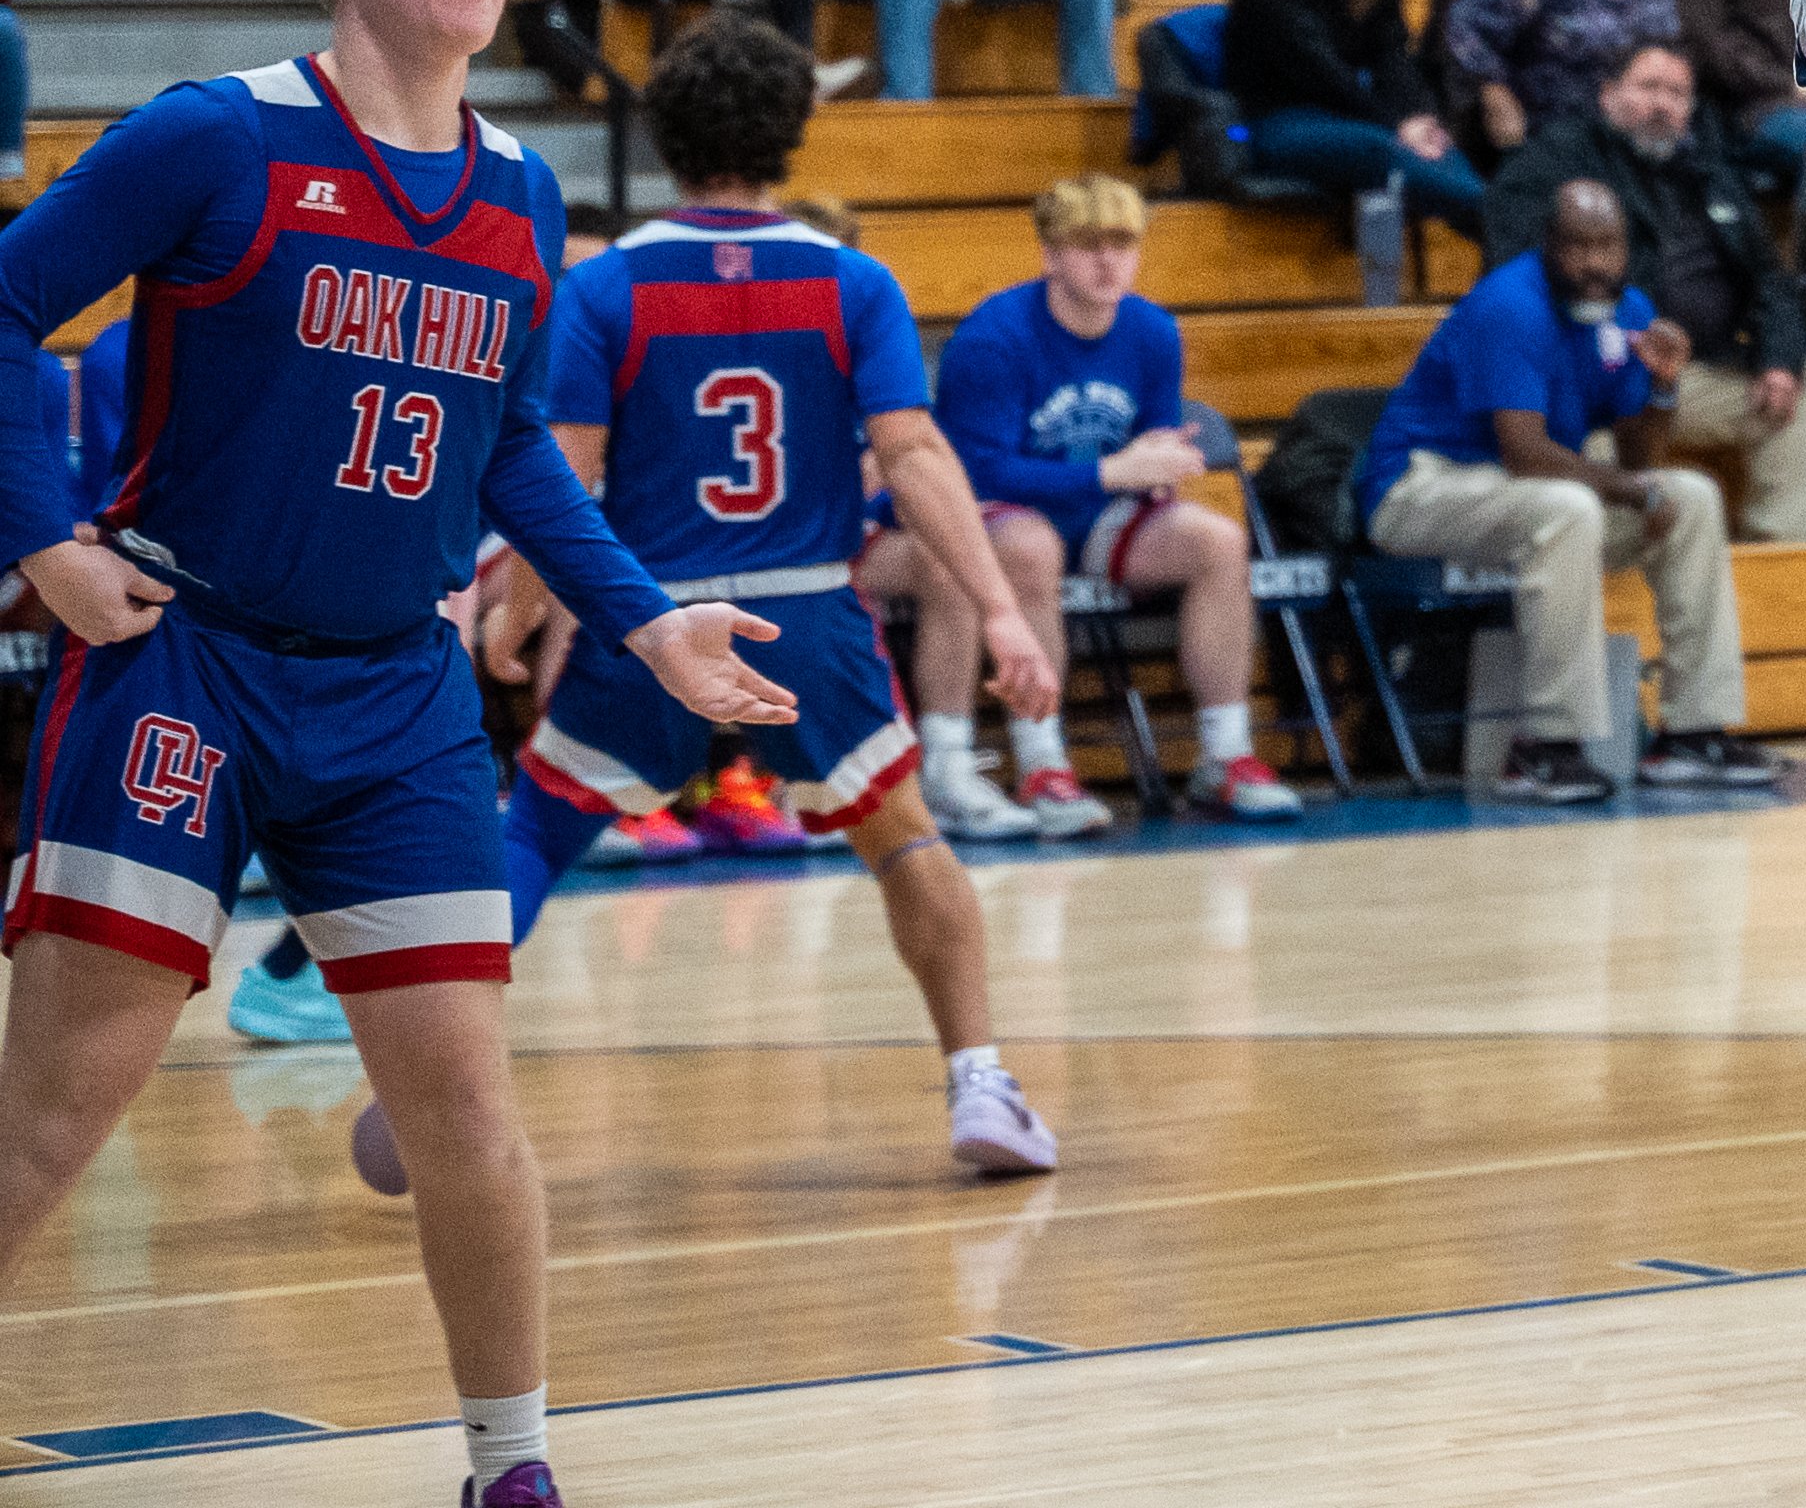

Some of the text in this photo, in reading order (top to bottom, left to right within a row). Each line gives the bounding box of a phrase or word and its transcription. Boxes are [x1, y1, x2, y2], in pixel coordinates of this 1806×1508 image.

[296, 264, 511, 383] OAK HILL
[335, 384, 444, 501] 13
[695, 368, 786, 522] 3
